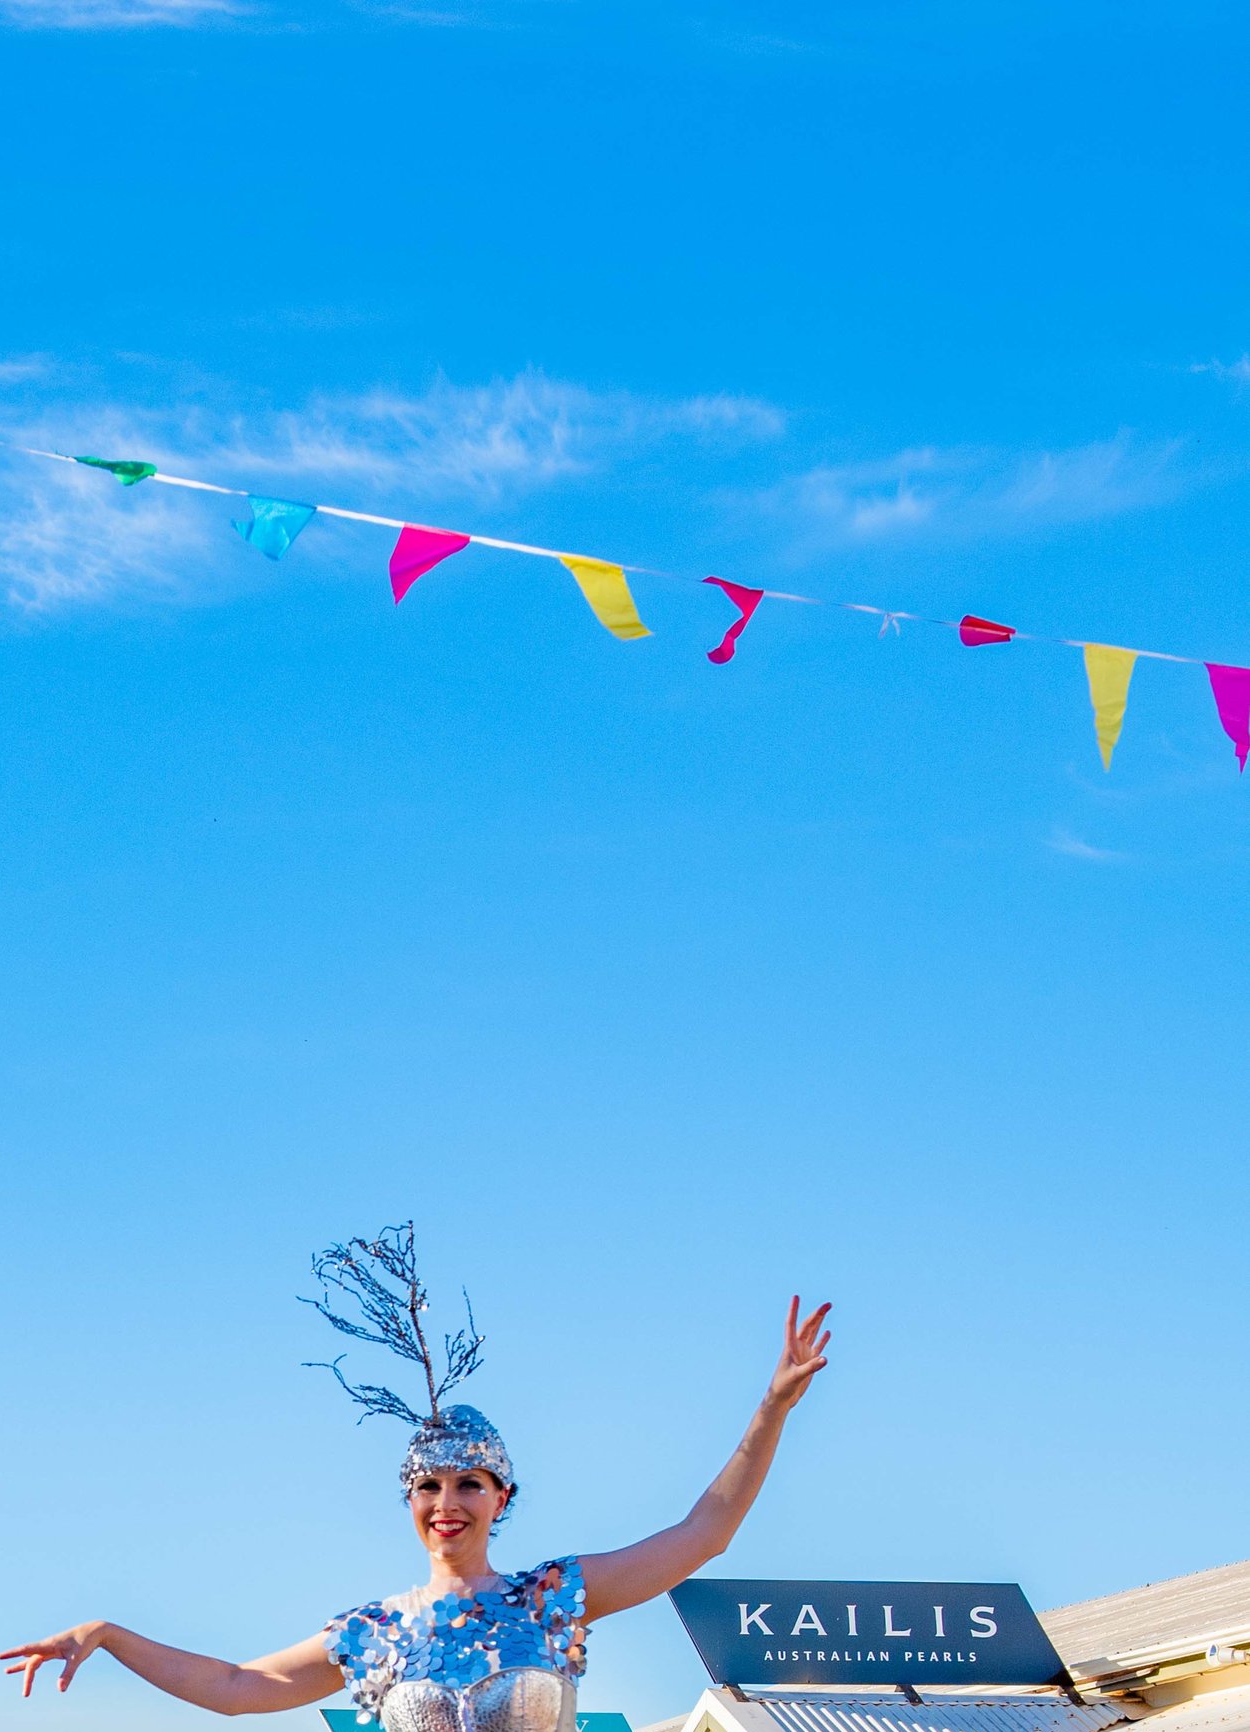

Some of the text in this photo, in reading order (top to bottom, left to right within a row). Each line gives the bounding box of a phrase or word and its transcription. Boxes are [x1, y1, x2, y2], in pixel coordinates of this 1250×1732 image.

[737, 1602, 999, 1638] KAILIS
[763, 1650, 978, 1663] AUSTRALIAN PEARLS
